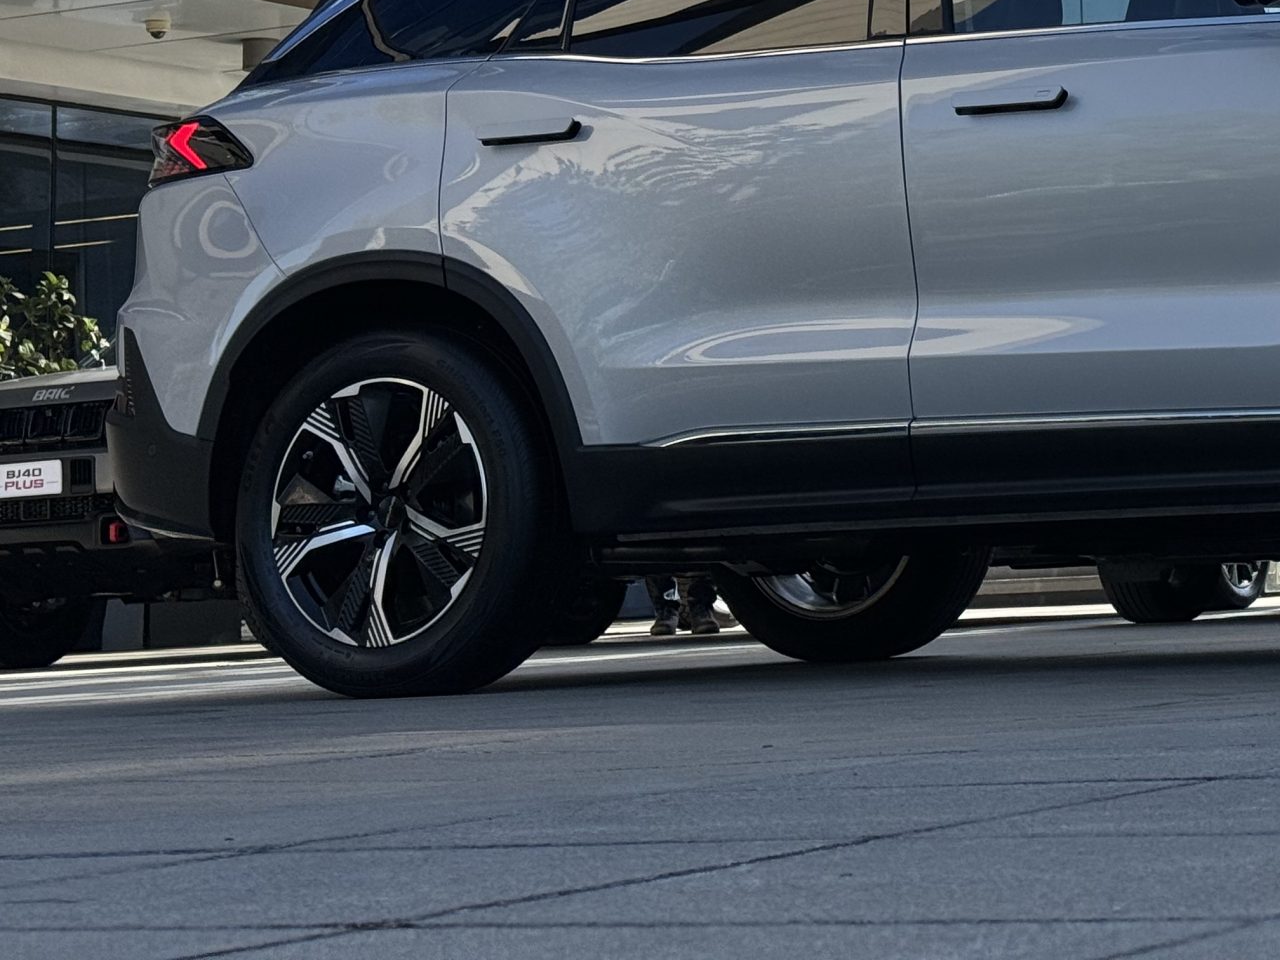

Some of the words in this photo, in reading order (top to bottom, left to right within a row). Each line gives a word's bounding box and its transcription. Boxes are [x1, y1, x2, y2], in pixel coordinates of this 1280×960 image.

[31, 386, 75, 401] BAIC
[6, 468, 42, 479] BJ40
[4, 479, 44, 491] PLUS
